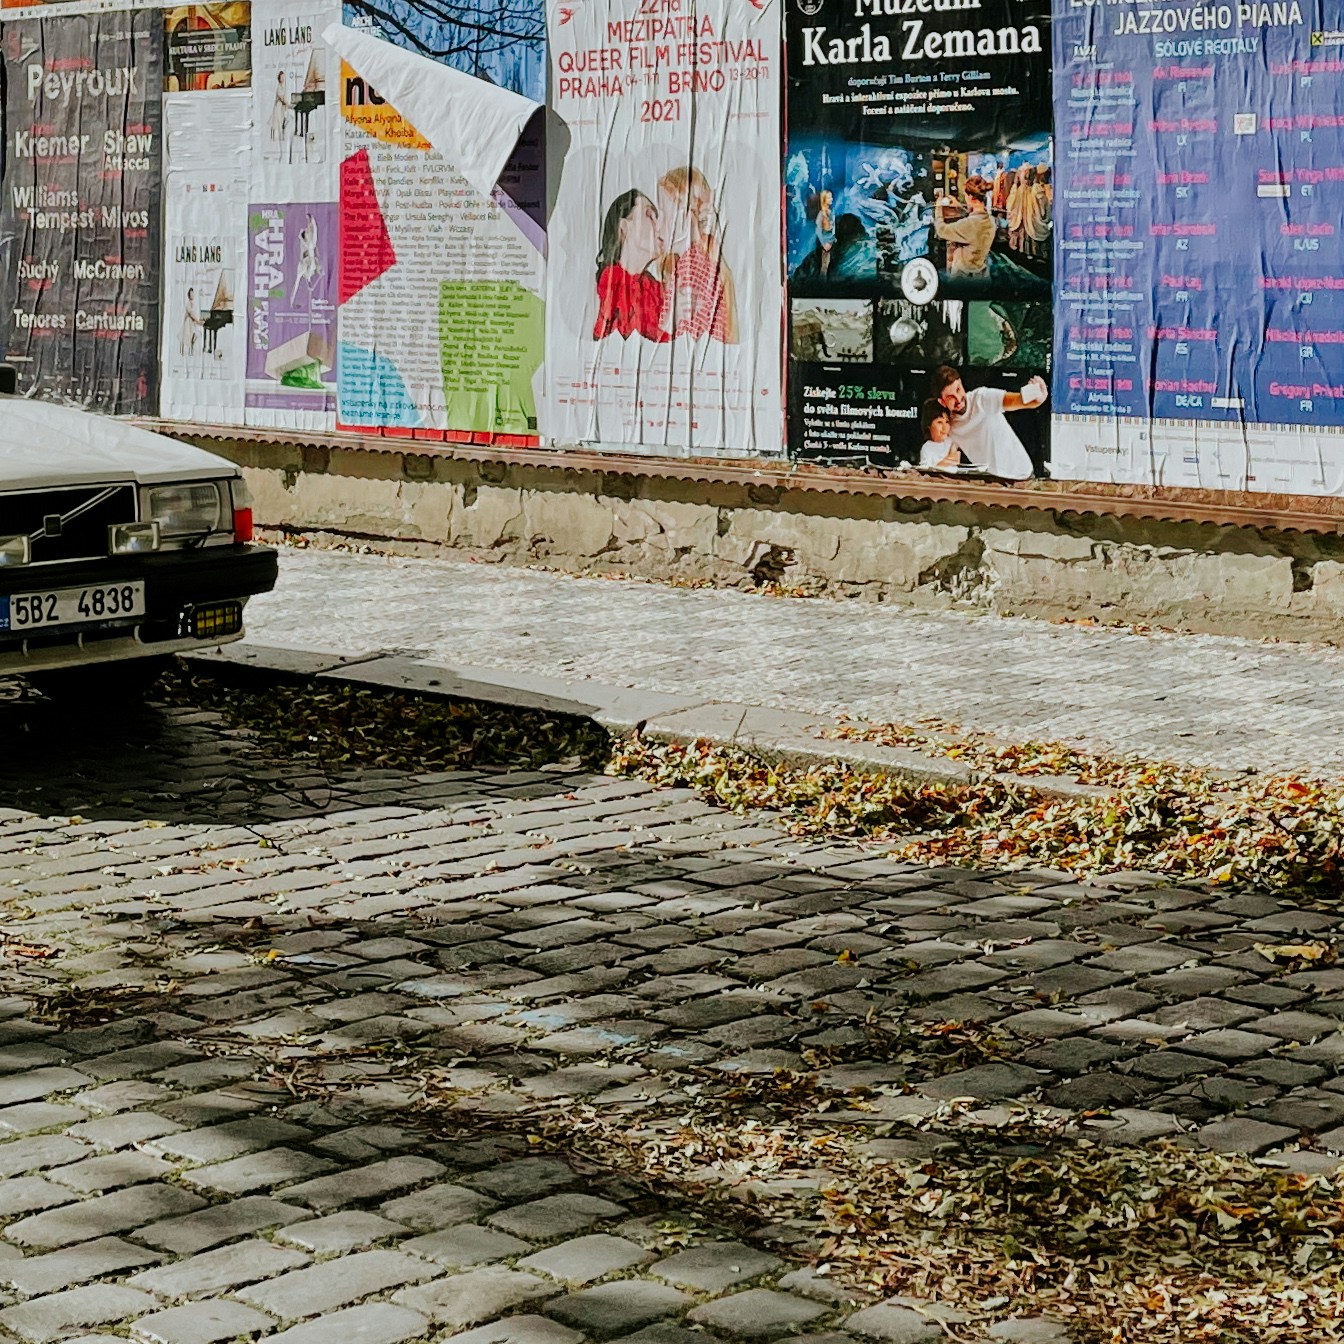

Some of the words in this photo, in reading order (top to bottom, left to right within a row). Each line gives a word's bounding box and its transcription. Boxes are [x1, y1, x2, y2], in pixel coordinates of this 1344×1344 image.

[607, 15, 714, 44] MEZIPATRA
[1114, 3, 1232, 36] JAZZOVÉHO
[1238, 1, 1303, 29] PIANA
[264, 27, 286, 47] LANG
[289, 25, 312, 44] LANG
[802, 23, 892, 66] Karla
[902, 19, 1042, 60] Zemana
[1155, 38, 1203, 57] SÓLOVÉ
[559, 48, 623, 73] QUEER
[629, 44, 671, 69] FILM
[677, 39, 769, 65] FESTIVAL
[27, 64, 138, 108] Peyroux
[560, 74, 624, 100] PRAHA
[669, 69, 726, 94] BRNO
[641, 98, 680, 123] 2021
[15, 130, 90, 157] Kremer
[104, 129, 153, 154] Shaw
[105, 155, 150, 171] Attacca
[13, 186, 78, 209] Williams
[27, 207, 95, 234] Tempest
[176, 246, 197, 263] LANG
[199, 246, 222, 264] LANG
[73, 260, 145, 280] McCraven
[13, 308, 67, 329] Tenores
[75, 309, 144, 331] Cantuaria
[838, 385, 865, 399] 25%
[867, 387, 896, 400] slevu
[803, 402, 815, 414] do
[15, 593, 59, 625] 5B2
[78, 585, 134, 618] 4838
